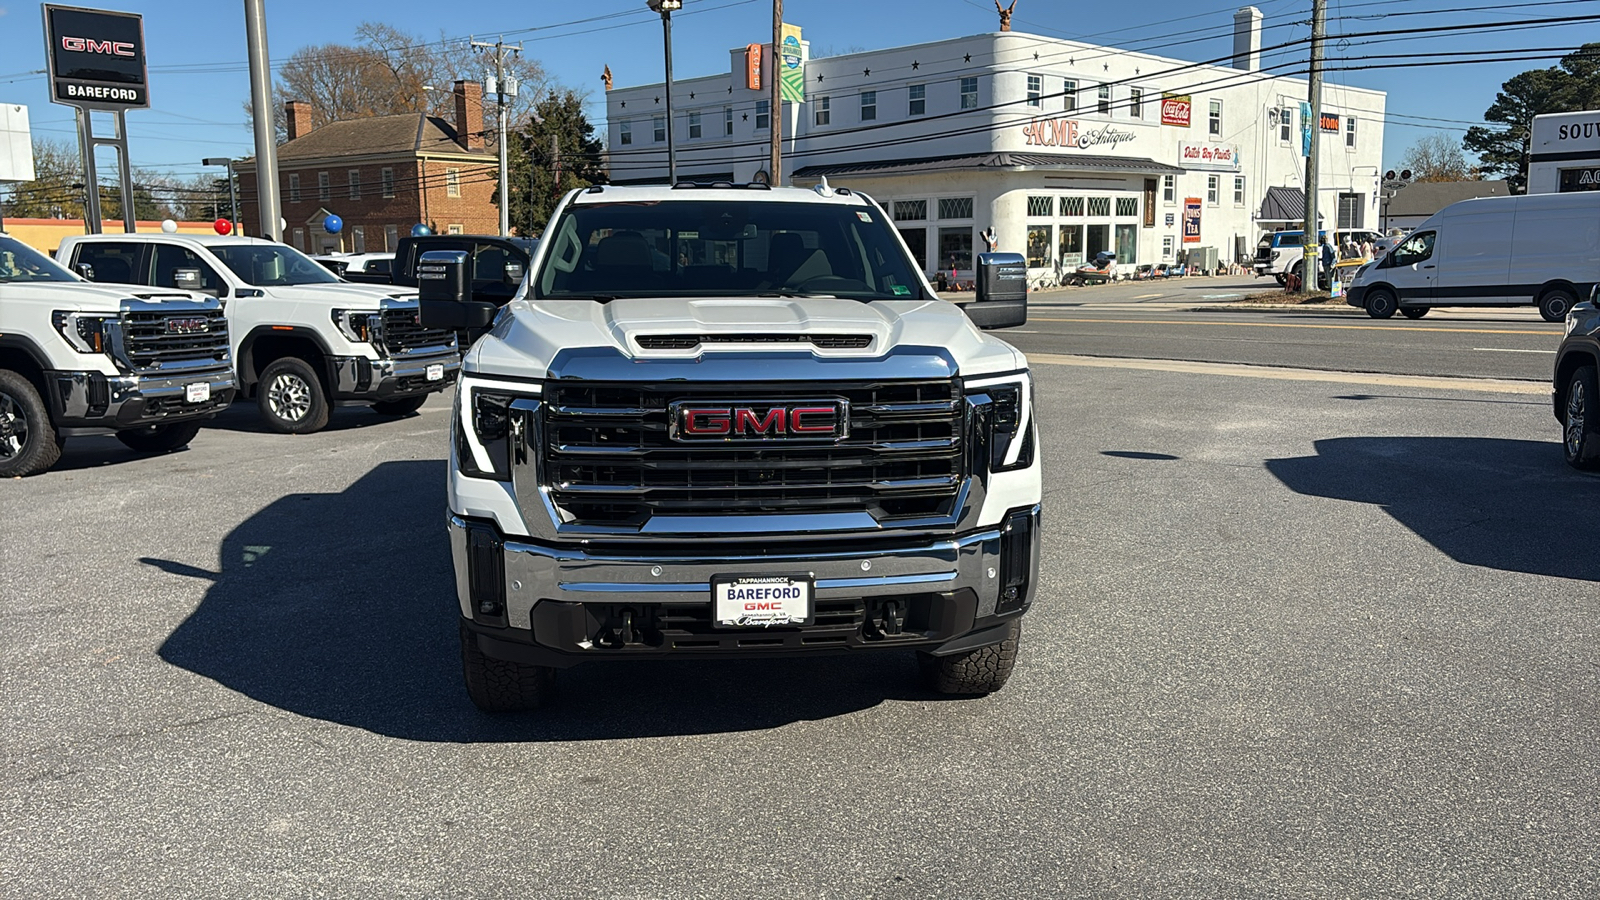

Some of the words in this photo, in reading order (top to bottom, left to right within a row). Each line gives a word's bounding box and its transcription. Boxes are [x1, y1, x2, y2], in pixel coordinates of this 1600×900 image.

[62, 36, 135, 57] GMC
[68, 85, 136, 100] BAREFORD
[1023, 118, 1079, 148] ACME
[1079, 124, 1137, 151] Antiques
[1184, 146, 1200, 159] Dutch
[1202, 147, 1213, 162] Boy
[1213, 147, 1231, 160] Paints
[1187, 223, 1199, 234] TEA
[685, 407, 836, 435] GMC
[738, 577, 789, 585] TAPPAHANNOCK
[727, 587, 801, 601] BAREFORD
[744, 602, 782, 611] GMC
[736, 615, 792, 629] Bareford
